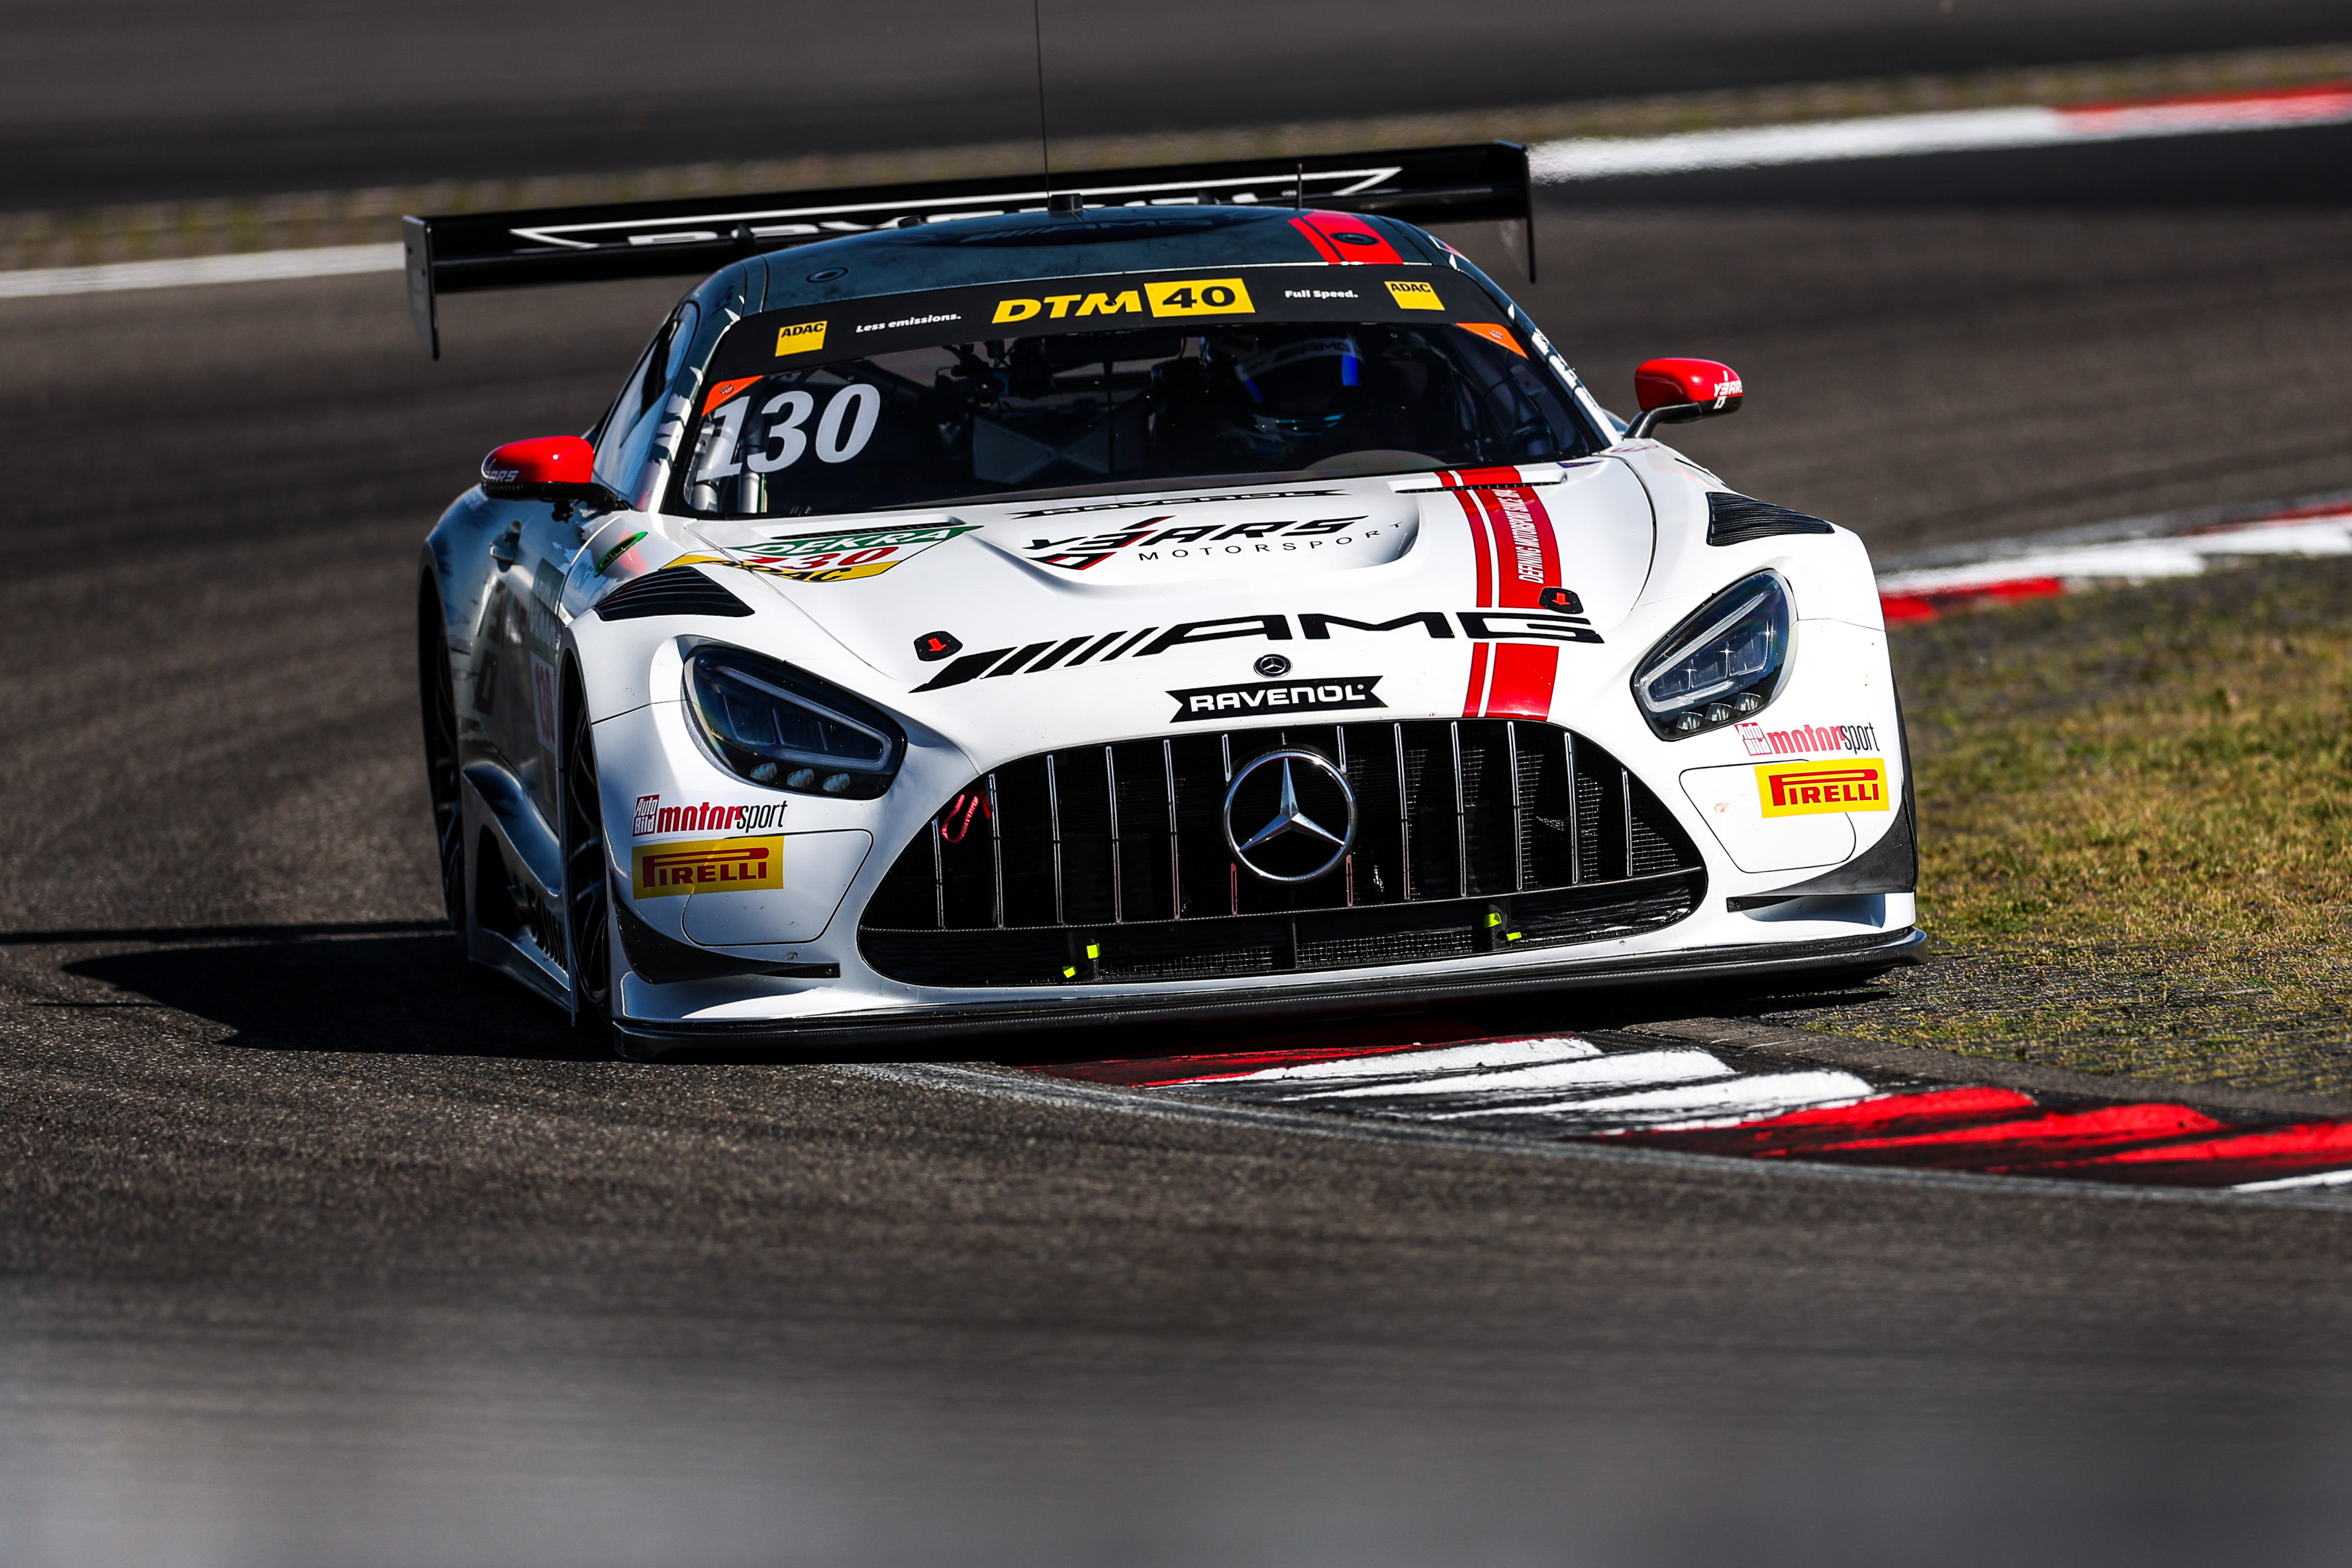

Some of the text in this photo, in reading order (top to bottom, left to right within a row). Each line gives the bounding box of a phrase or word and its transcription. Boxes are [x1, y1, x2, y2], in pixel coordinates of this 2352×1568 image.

[1285, 289, 1358, 299] Full Speed.
[1390, 283, 1431, 293] ADAC
[992, 285, 1236, 324] DTM 40
[781, 322, 824, 338] ADAC
[856, 313, 961, 333] Less emissions.
[695, 383, 881, 481] 130
[1497, 497, 1528, 512] SINCE
[1504, 511, 1540, 548] MOTORSPORT
[742, 529, 951, 554] DEKRA
[1138, 522, 1402, 562] MOTORSPORT
[1515, 546, 1544, 584] DEFINING
[1189, 684, 1365, 712] RAVENOL
[1737, 724, 1763, 740] Auto
[1743, 738, 1772, 754] Bild
[1769, 769, 1879, 807] PIRELLI
[635, 797, 658, 817] Auto
[634, 816, 655, 834] Bild
[642, 848, 769, 888] PIRELLI
